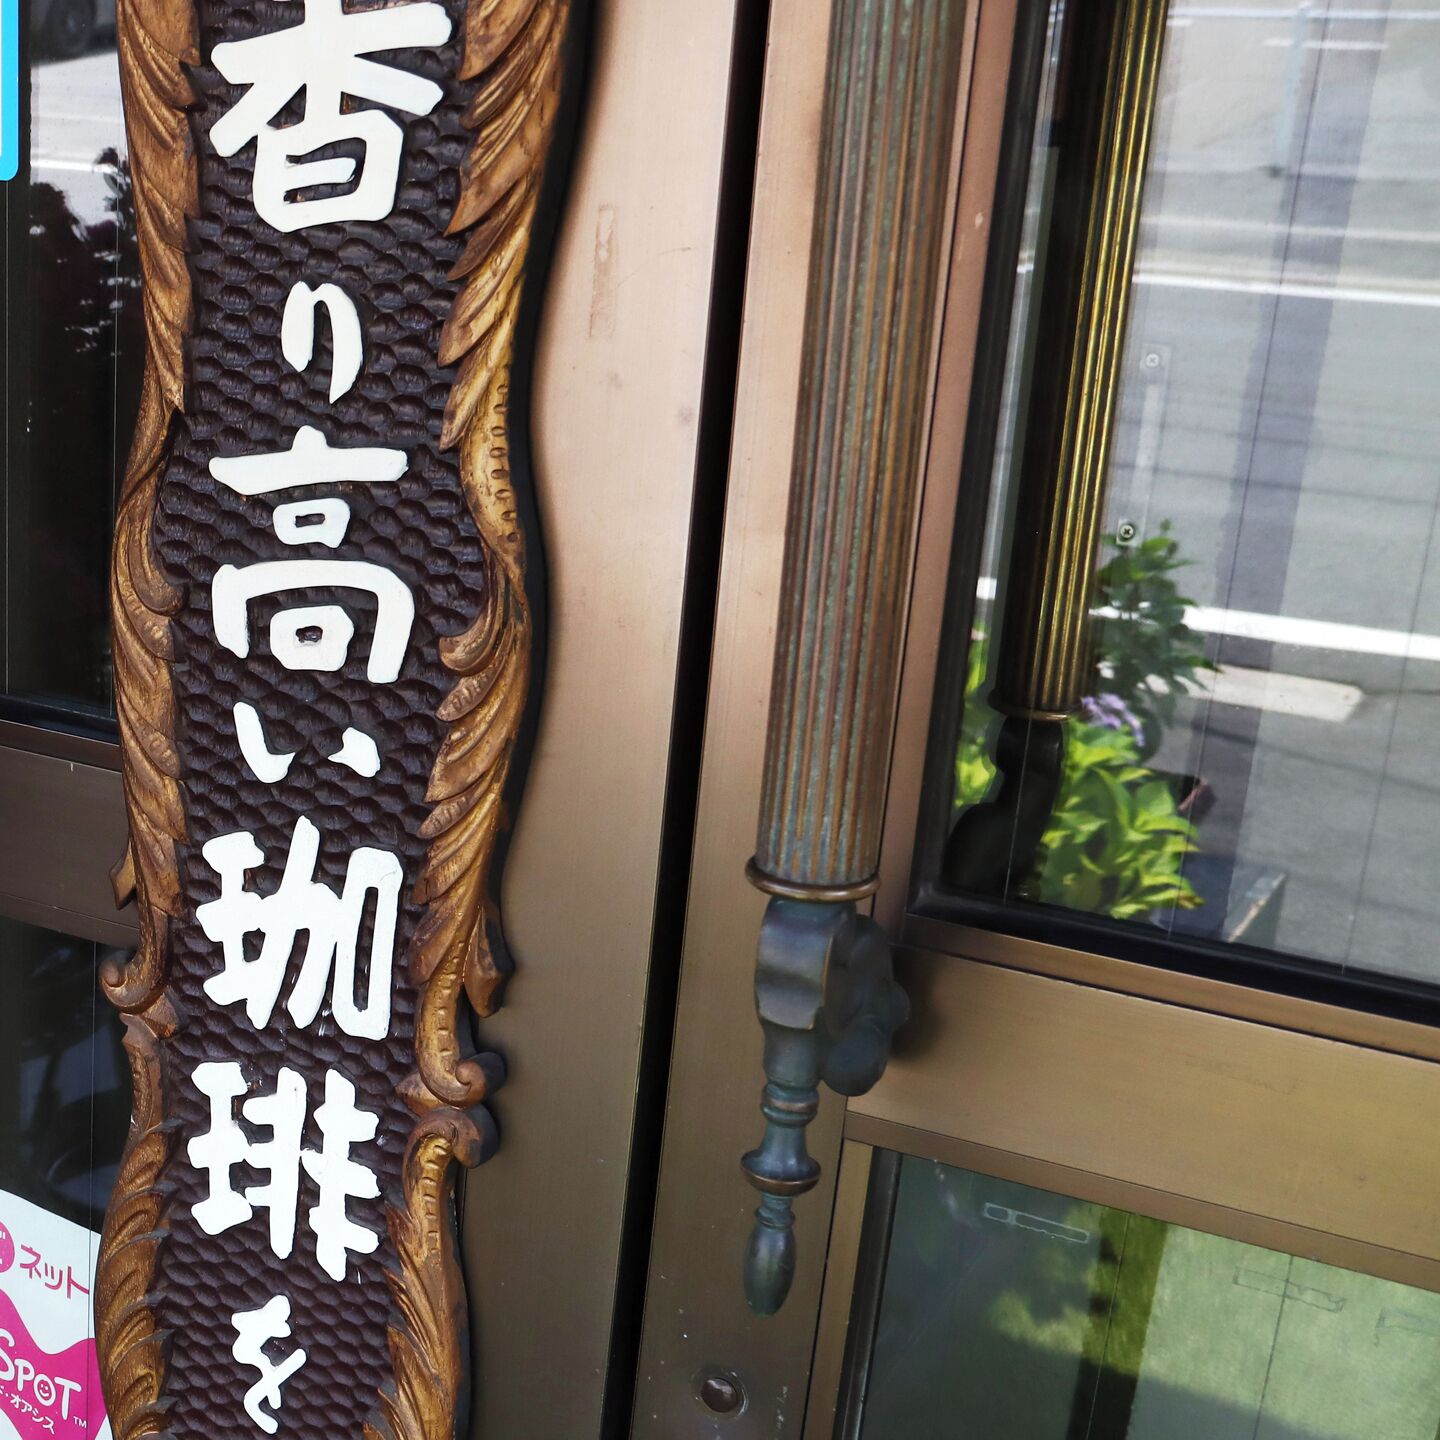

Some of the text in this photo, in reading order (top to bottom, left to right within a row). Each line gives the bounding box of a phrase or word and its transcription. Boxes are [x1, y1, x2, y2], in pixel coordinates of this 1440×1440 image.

[187, 0, 452, 1434] 香り高い珈琲を
